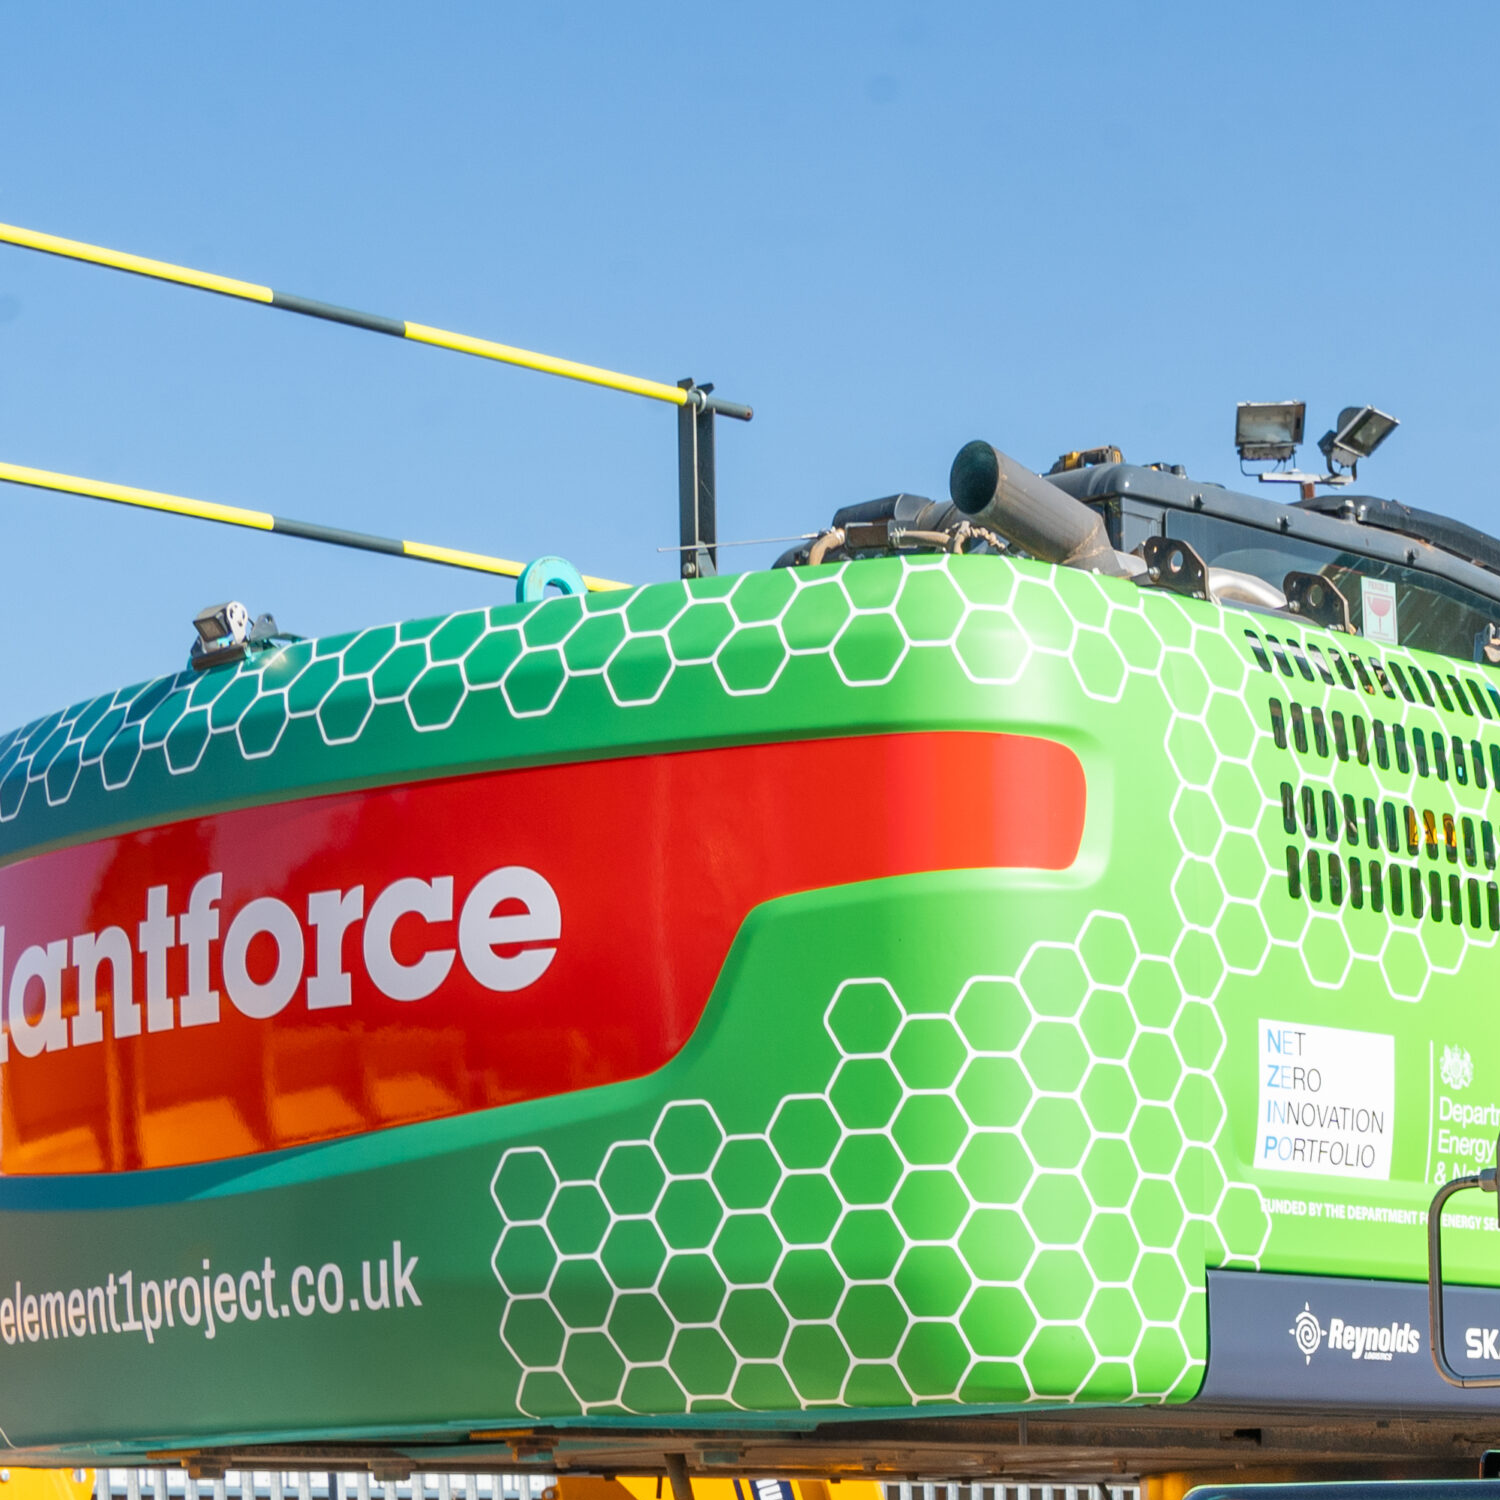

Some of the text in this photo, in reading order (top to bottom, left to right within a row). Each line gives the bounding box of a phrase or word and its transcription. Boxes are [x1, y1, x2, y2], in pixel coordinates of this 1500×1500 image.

[1267, 1028, 1306, 1057] NET
[1267, 1064, 1322, 1093] ZERO
[1267, 1099, 1384, 1134] INNOVATION
[1264, 1135, 1376, 1169] PORTFOLIO
[1438, 1128, 1497, 1164] Energy
[1434, 1160, 1447, 1185] &
[1261, 1198, 1307, 1216] FUNDED
[1308, 1202, 1323, 1217] BY
[1325, 1203, 1345, 1219] THE
[1347, 1205, 1418, 1225] DEPARTMENT
[1442, 1213, 1482, 1230] ENERGY
[0, 1240, 423, 1345] element1project.co.uk
[1328, 1318, 1421, 1360] Reynolds
